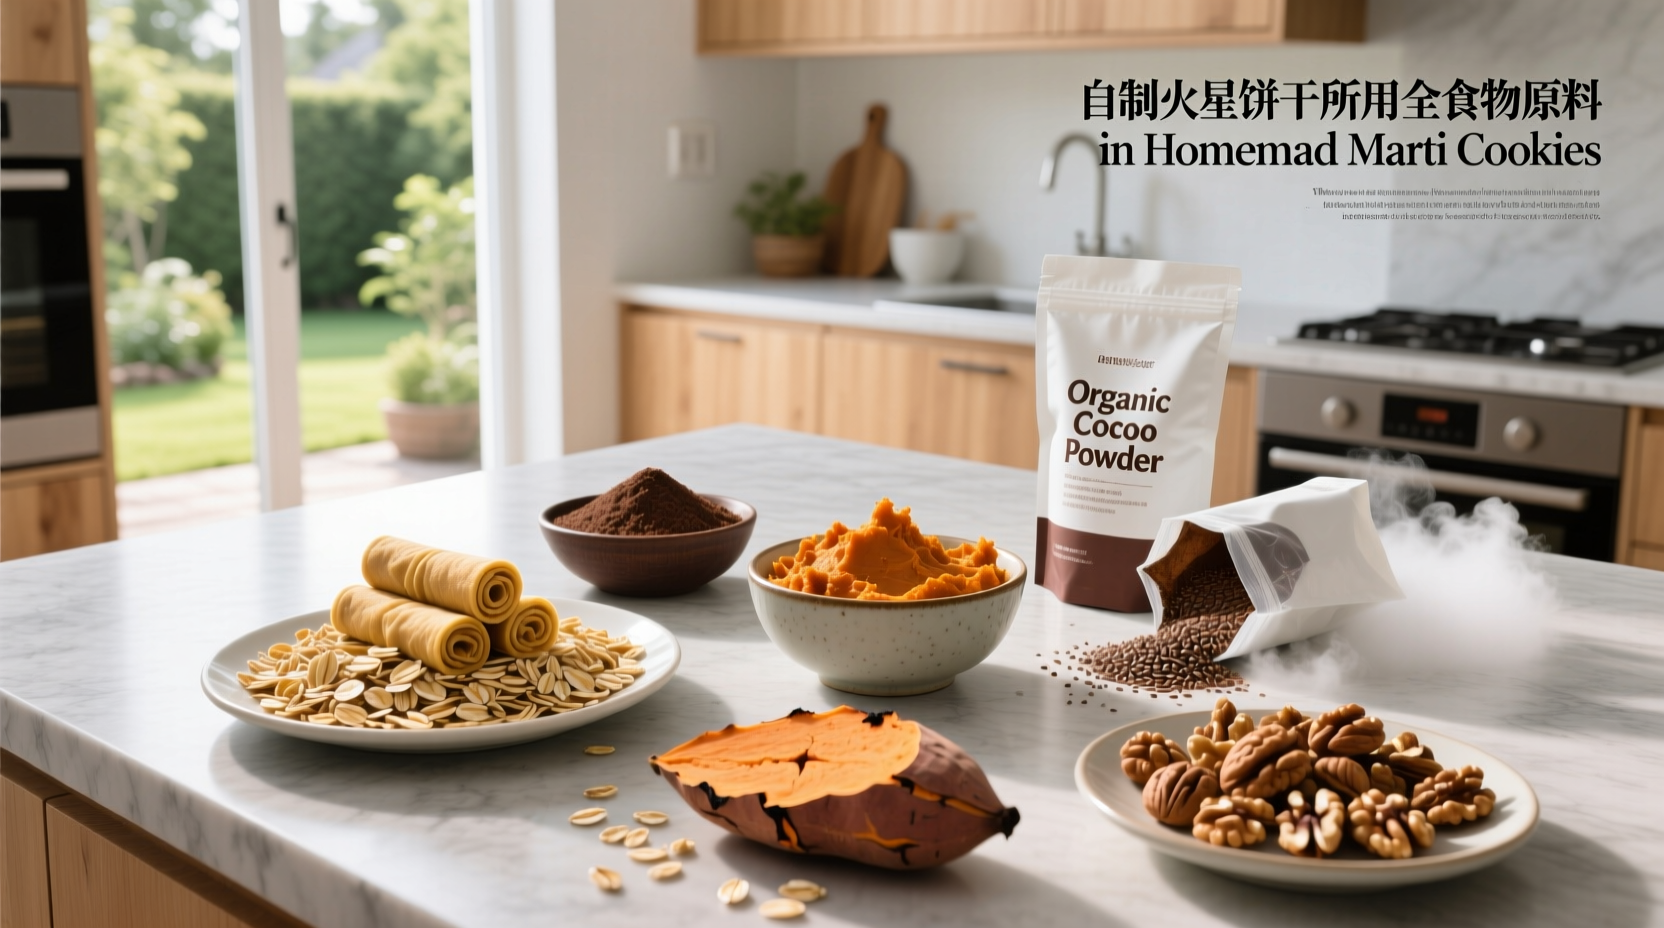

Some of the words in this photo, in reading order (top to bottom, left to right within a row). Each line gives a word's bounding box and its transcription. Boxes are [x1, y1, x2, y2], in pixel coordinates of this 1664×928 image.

[1067, 379, 1171, 415] Organic
[1073, 410, 1158, 442] Cocoo
[1064, 438, 1164, 473] Powder
